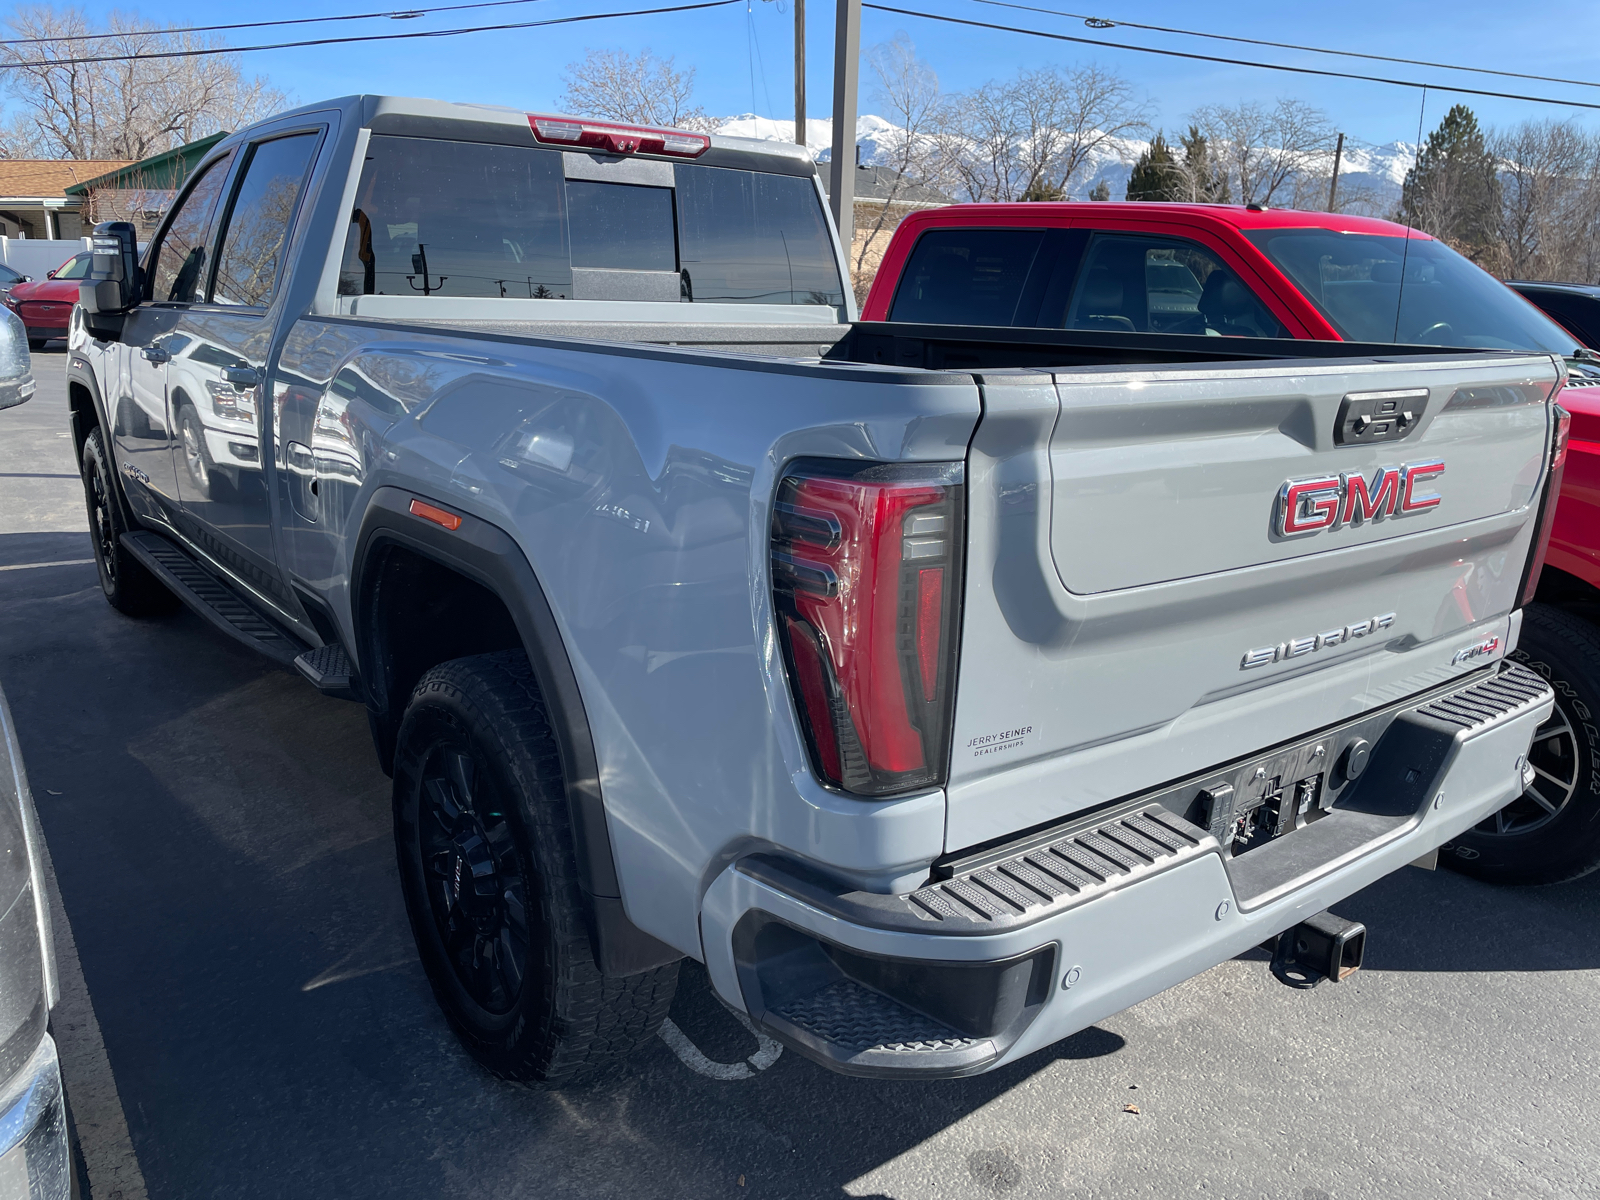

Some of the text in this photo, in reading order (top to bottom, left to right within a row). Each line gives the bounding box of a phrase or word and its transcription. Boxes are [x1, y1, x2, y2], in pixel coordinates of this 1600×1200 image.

[1275, 458, 1446, 538] GMC
[1239, 611, 1397, 670] SIERRA
[966, 726, 1033, 748] JERRY SEINER
[974, 740, 1024, 757] DEALERSHIPS
[1509, 648, 1600, 795] RANGLER
